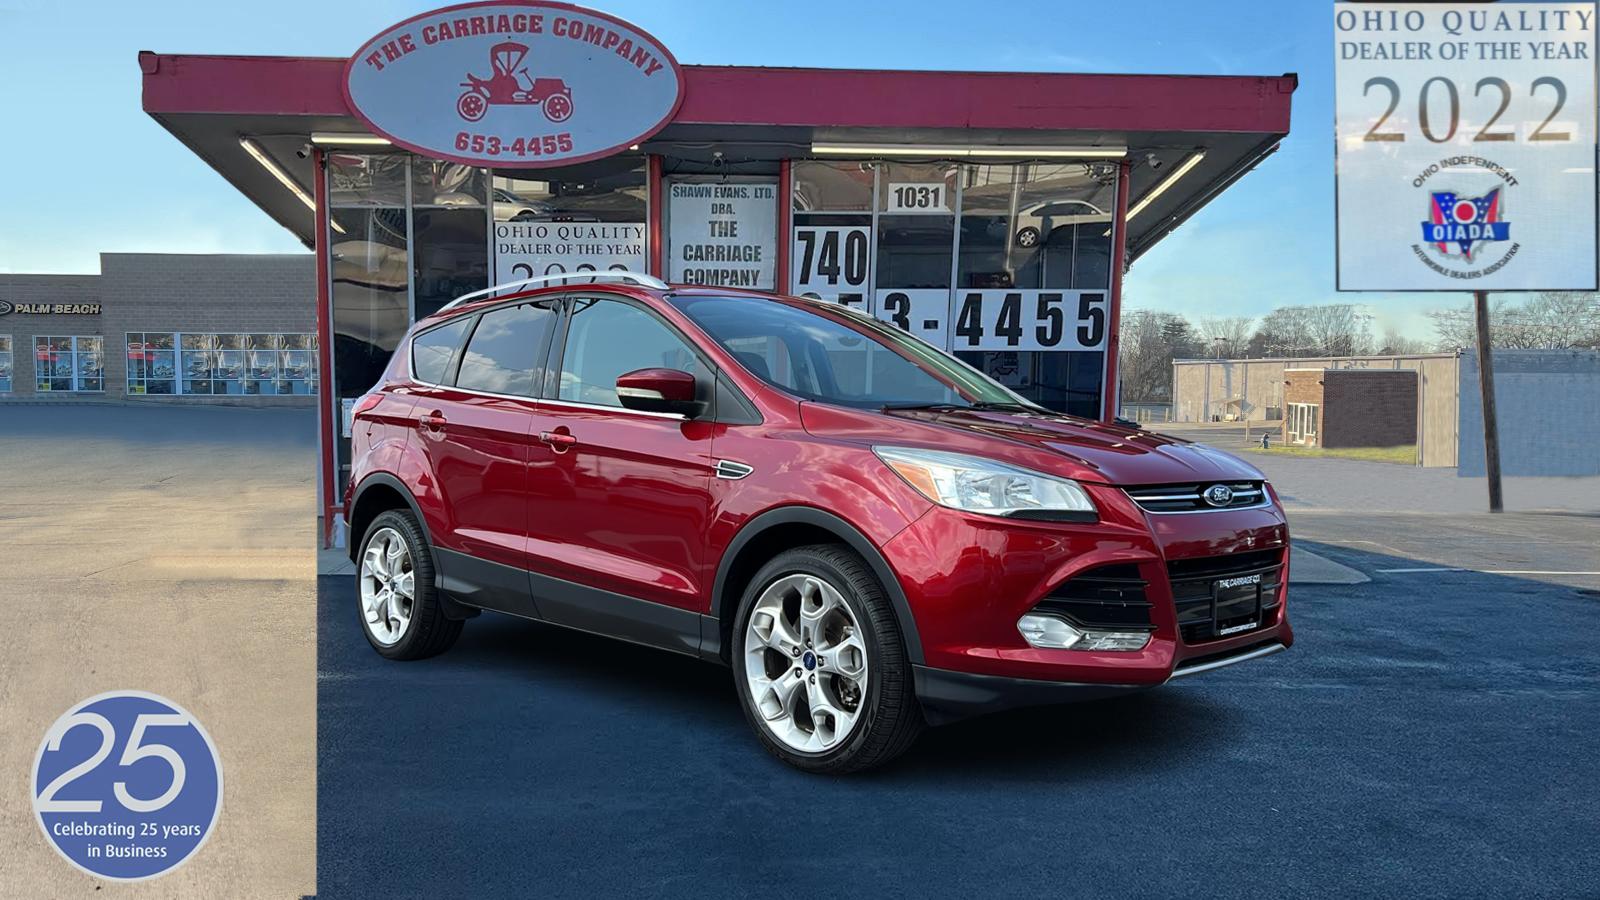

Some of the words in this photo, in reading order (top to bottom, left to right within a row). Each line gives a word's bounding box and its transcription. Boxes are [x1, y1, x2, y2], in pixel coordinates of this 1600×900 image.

[1336, 10, 1425, 32] OHIO
[1442, 10, 1593, 36] QUALITY
[365, 33, 417, 72] THE
[422, 14, 544, 46] CARRIAGE
[552, 16, 665, 77] COMPANY
[1340, 41, 1433, 60] DEALER
[1438, 41, 1469, 60] OF
[1475, 41, 1522, 60] THE
[1528, 41, 1589, 60] YEAR
[1363, 76, 1571, 144] 2022
[455, 131, 573, 156] 653-4455
[1413, 163, 1440, 188] OHIO
[1440, 155, 1519, 188] INDEPENDENT
[672, 186, 711, 198] SHAWN
[754, 187, 774, 199] LTD.
[894, 186, 941, 209] 1031
[711, 203, 736, 215] DBA.
[497, 226, 548, 239] OHIO
[557, 226, 644, 240] QUALITY
[708, 220, 738, 238] THE
[1432, 224, 1496, 240] OIADA
[500, 243, 552, 255] DEALER
[555, 243, 573, 255] OF
[576, 244, 603, 255] THE
[606, 244, 642, 255] YEAR
[683, 244, 762, 262] CARRIAGE
[798, 230, 868, 286] 740
[683, 268, 760, 286] COMPANY
[15, 303, 51, 314] PALM
[54, 303, 100, 314] BEACH
